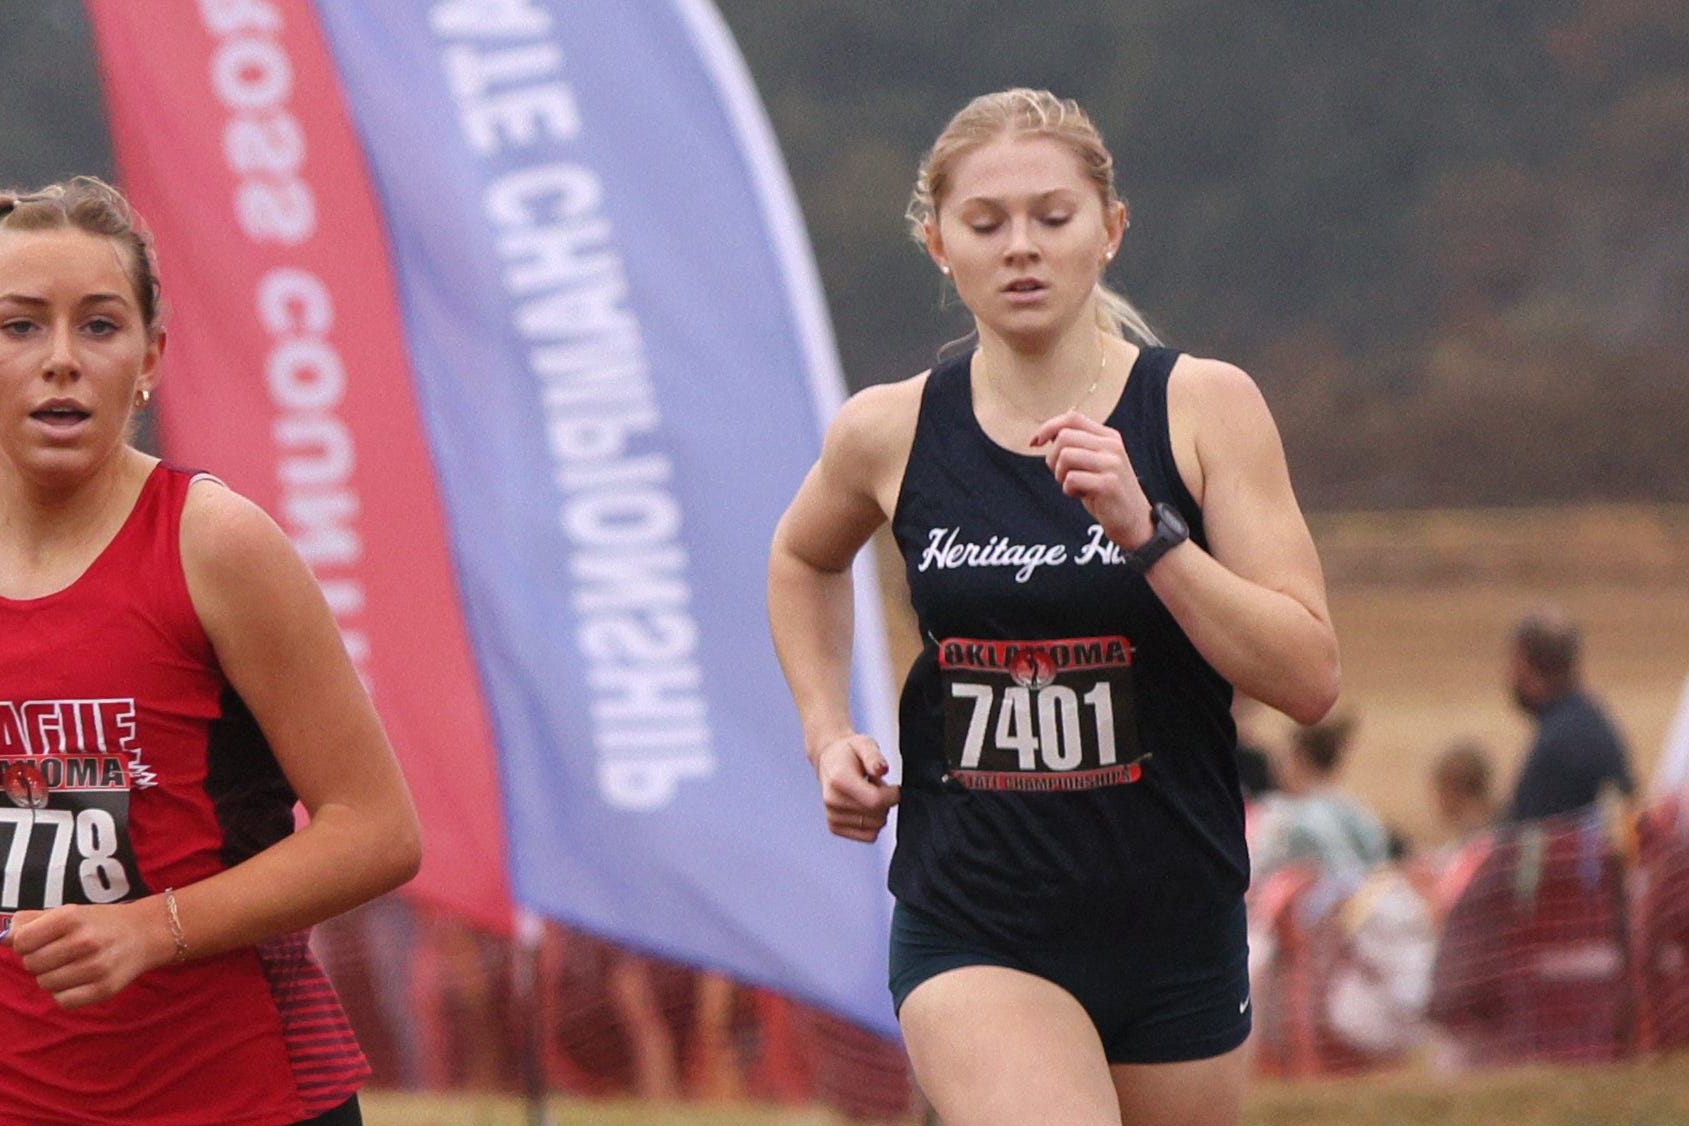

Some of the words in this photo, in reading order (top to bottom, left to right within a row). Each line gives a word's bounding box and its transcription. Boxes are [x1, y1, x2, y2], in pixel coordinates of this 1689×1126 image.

[918, 526, 1067, 583] Heritage
[944, 640, 1126, 668] OKLAOMA
[951, 681, 1117, 771] 7401
